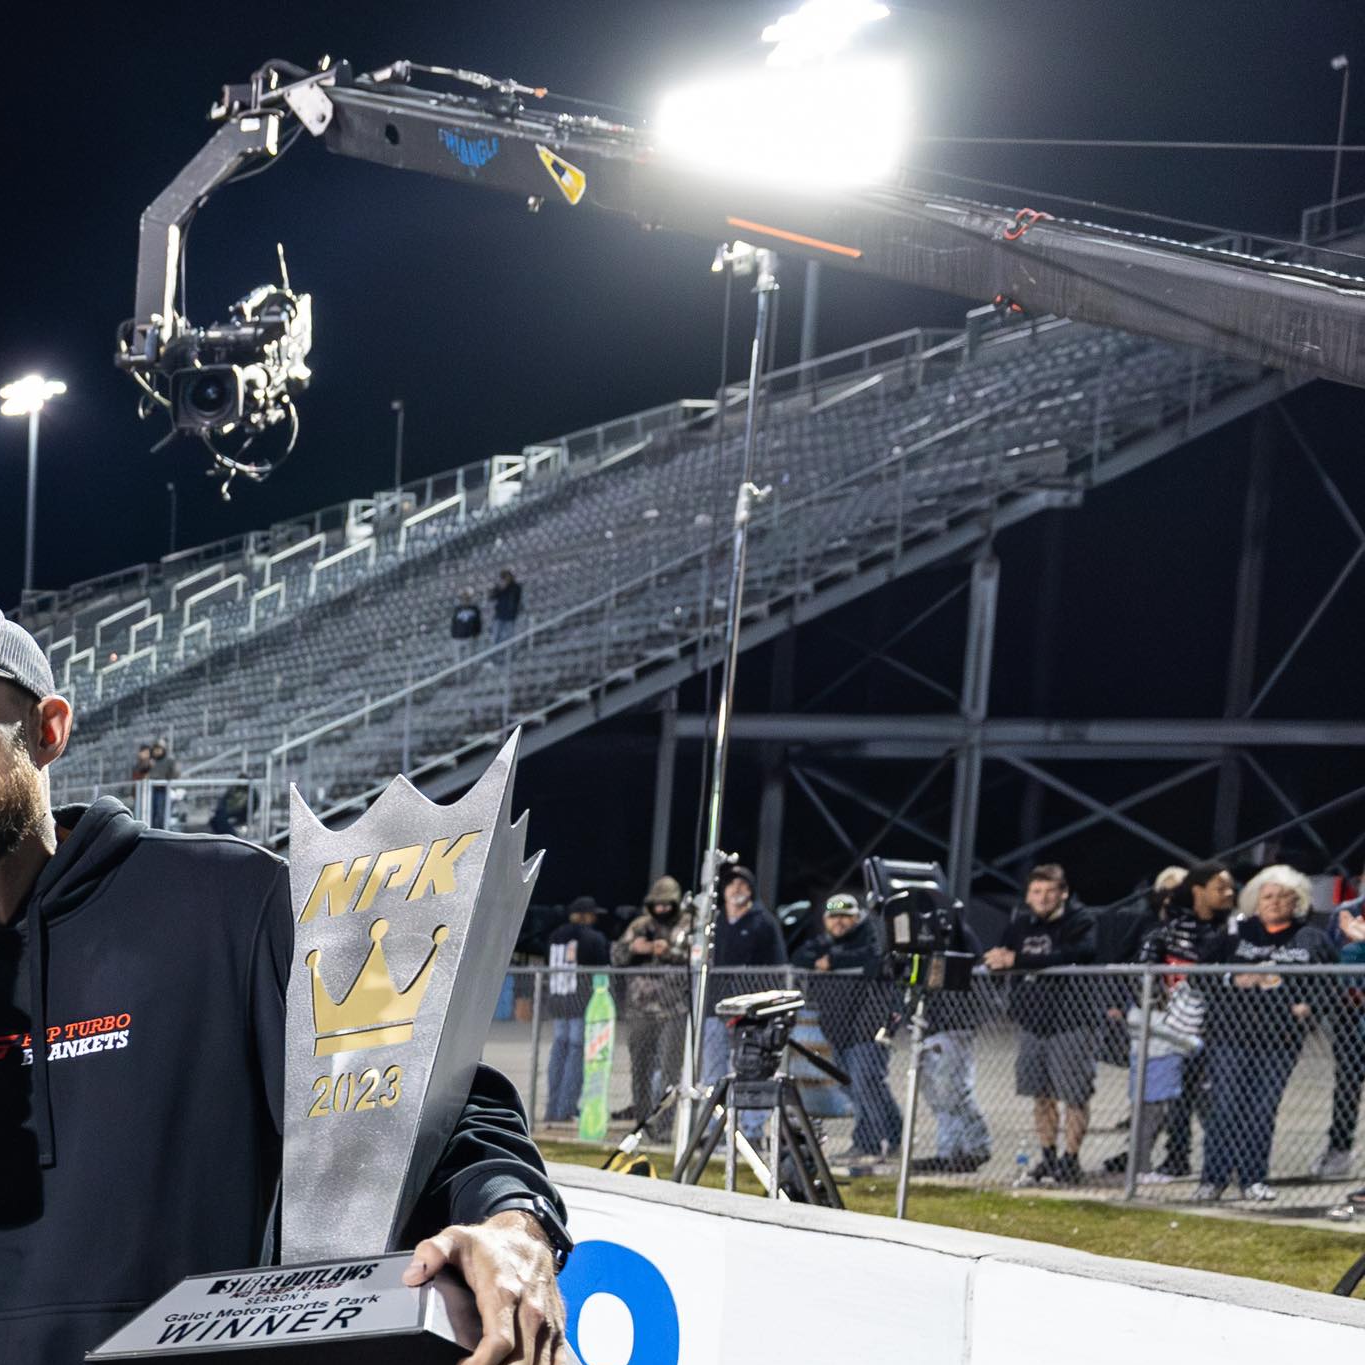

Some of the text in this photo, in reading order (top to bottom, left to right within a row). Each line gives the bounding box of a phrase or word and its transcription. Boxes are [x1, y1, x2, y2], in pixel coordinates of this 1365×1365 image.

[298, 829, 483, 925] NPK
[64, 1012, 132, 1039] TURBO
[21, 1029, 130, 1066] BANKETS
[307, 1066, 404, 1119] 2023
[164, 1293, 382, 1324] Galot Motorsports Park
[245, 1293, 293, 1306] SEASON
[157, 1306, 363, 1345] WINNER
